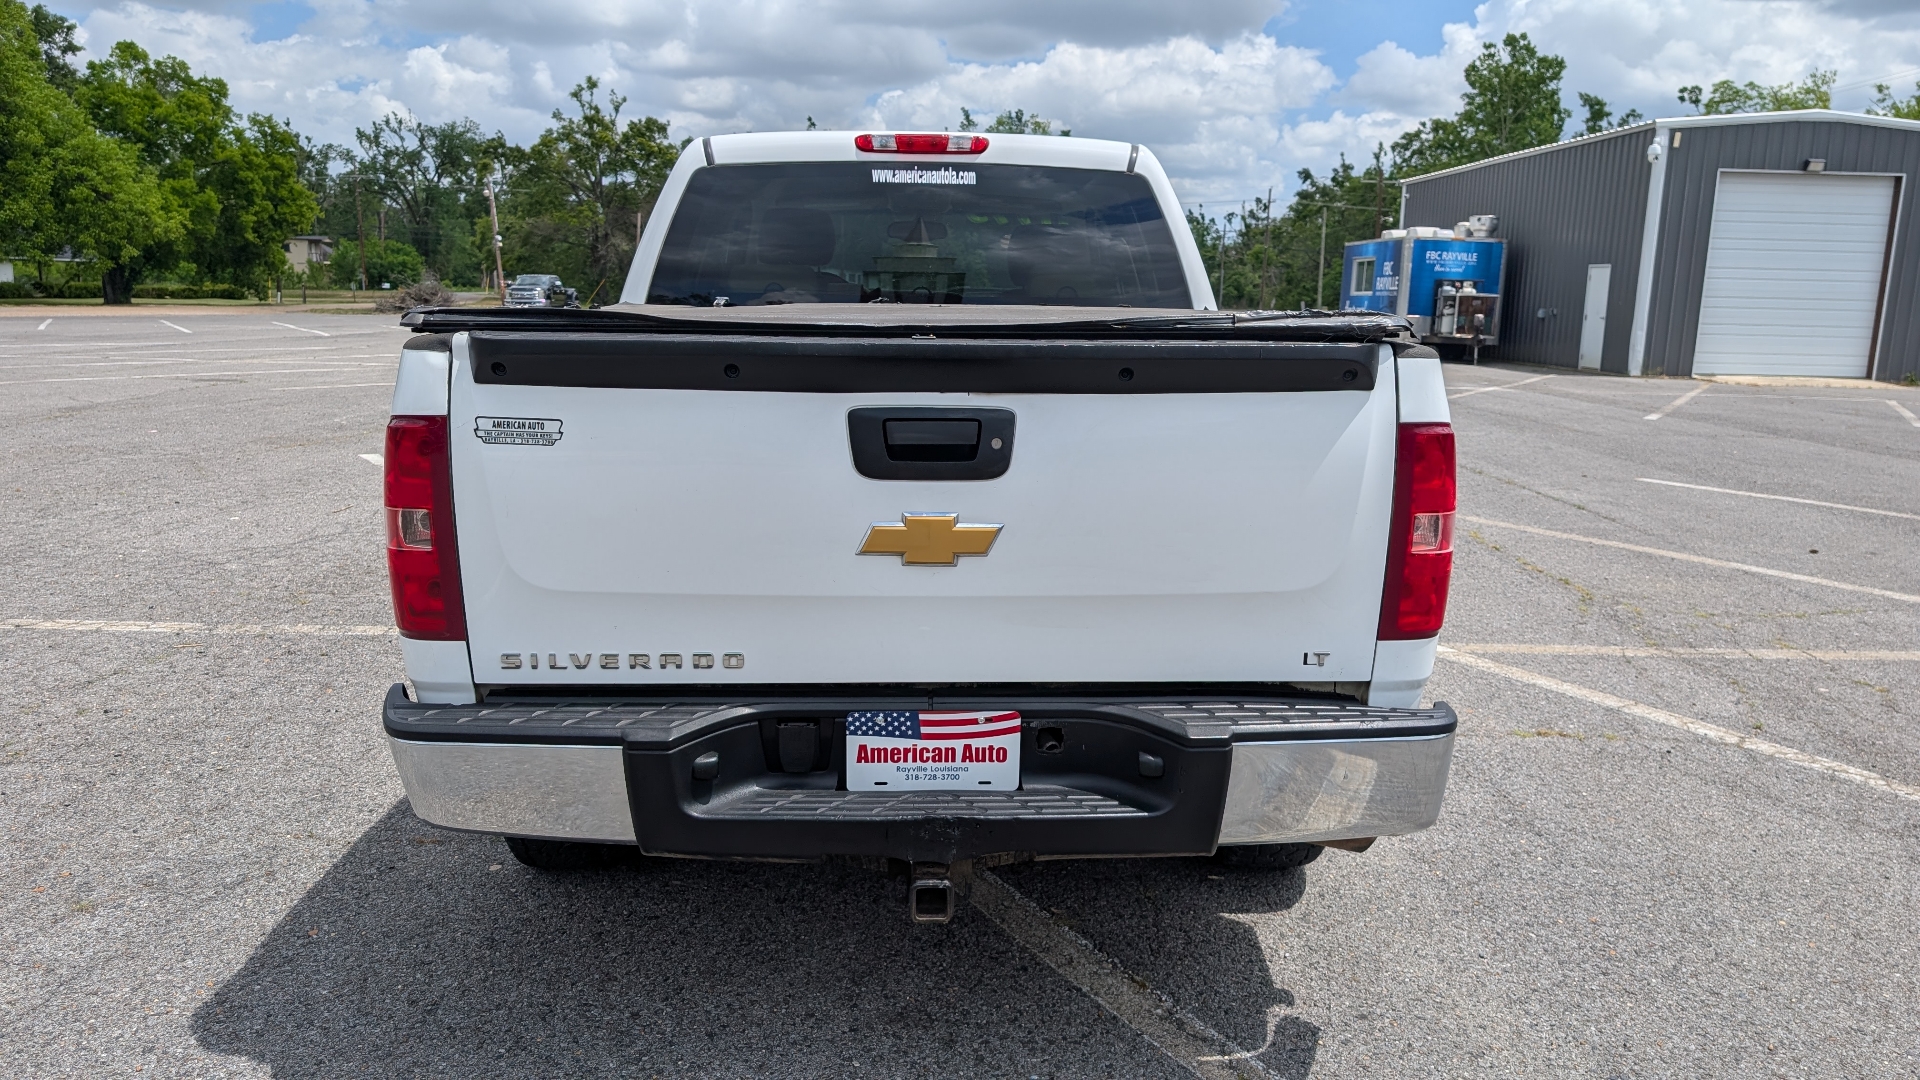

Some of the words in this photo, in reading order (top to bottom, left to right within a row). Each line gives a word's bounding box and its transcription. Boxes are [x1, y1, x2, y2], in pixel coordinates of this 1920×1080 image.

[871, 165, 977, 185] www.americanautola.com
[1426, 250, 1441, 260] FBC
[1442, 251, 1478, 262] RAYVILLE
[1382, 261, 1394, 276] FBC
[1375, 276, 1399, 291] RAYVILLE
[491, 420, 526, 430] AMERICAN
[527, 421, 545, 431] AUTO
[500, 652, 745, 670] SILVERADO
[1303, 651, 1330, 667] LT
[856, 743, 957, 764] American
[961, 743, 1008, 763] Auto
[896, 765, 928, 774] Rayville
[930, 765, 969, 773] Louisiana
[904, 773, 960, 781] 318-728-3700
